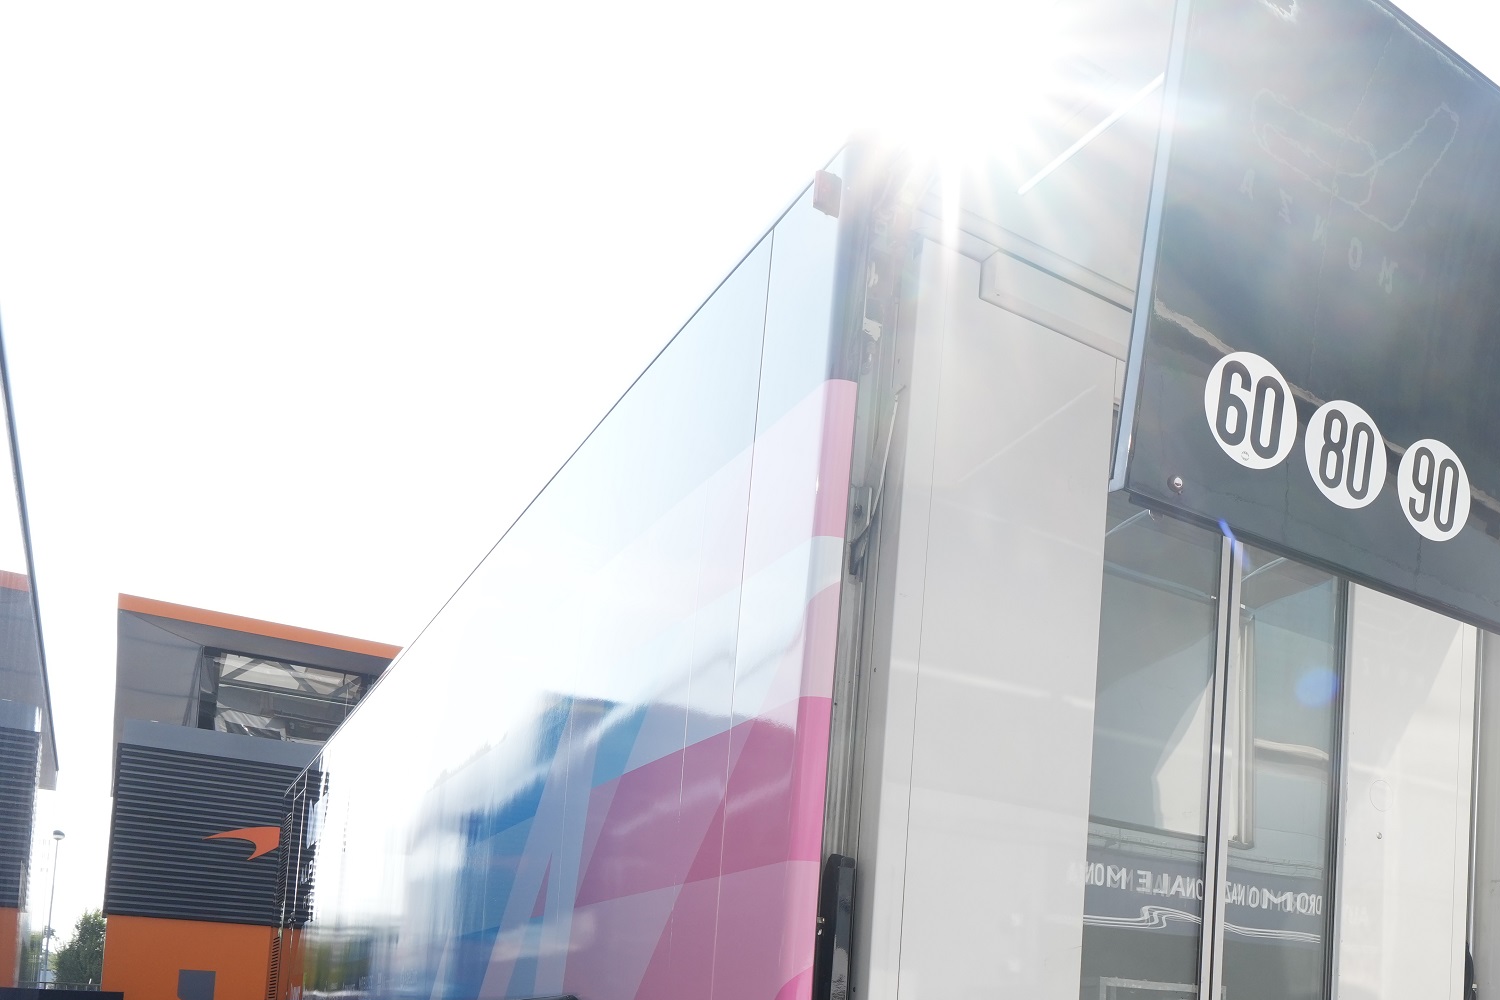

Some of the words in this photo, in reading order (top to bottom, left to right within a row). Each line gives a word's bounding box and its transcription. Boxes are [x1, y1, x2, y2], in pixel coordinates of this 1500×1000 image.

[1216, 360, 1284, 460] 60
[1319, 409, 1375, 500] 80
[1408, 446, 1460, 533] 90
